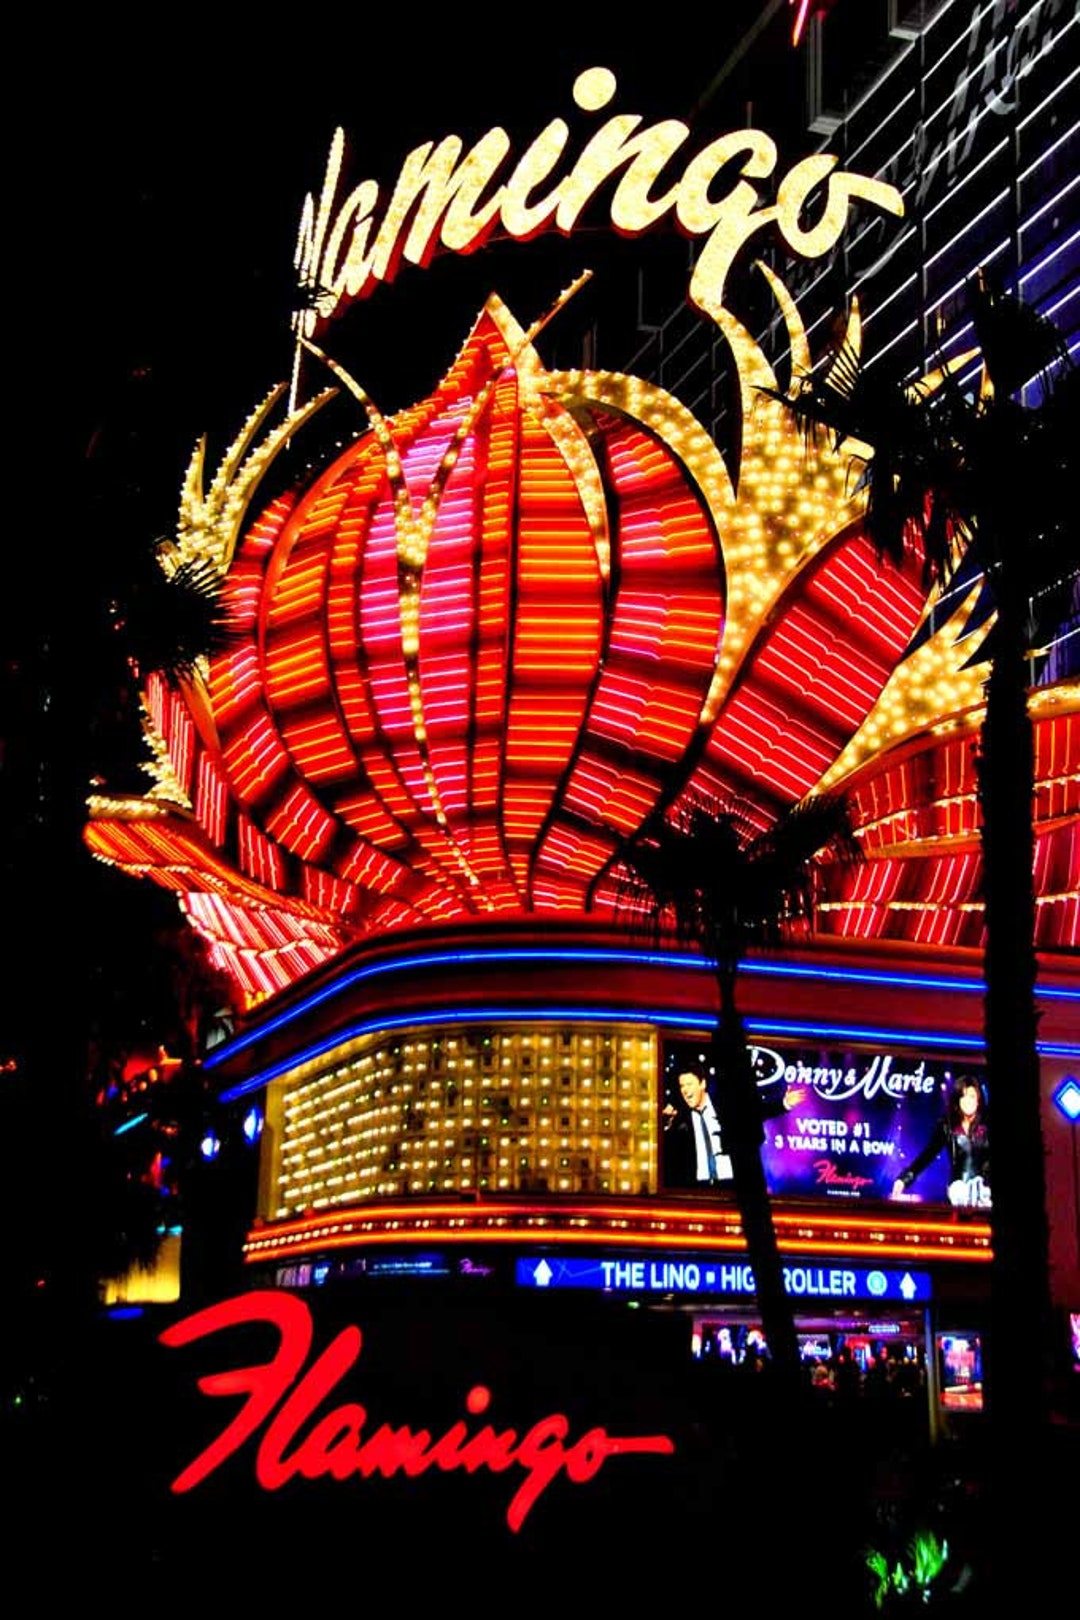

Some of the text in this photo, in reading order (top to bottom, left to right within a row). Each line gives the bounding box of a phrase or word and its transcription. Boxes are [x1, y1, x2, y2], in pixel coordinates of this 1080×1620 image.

[745, 1044, 936, 1101] Donny & Marie
[796, 1118, 871, 1139] VOTED #1
[774, 1134, 895, 1156] 3 YEARS IN A ROW
[601, 1262, 645, 1288] THE
[651, 1264, 700, 1290] LINQ
[720, 1264, 756, 1292] HIG
[159, 1290, 674, 1532] Flamingo
